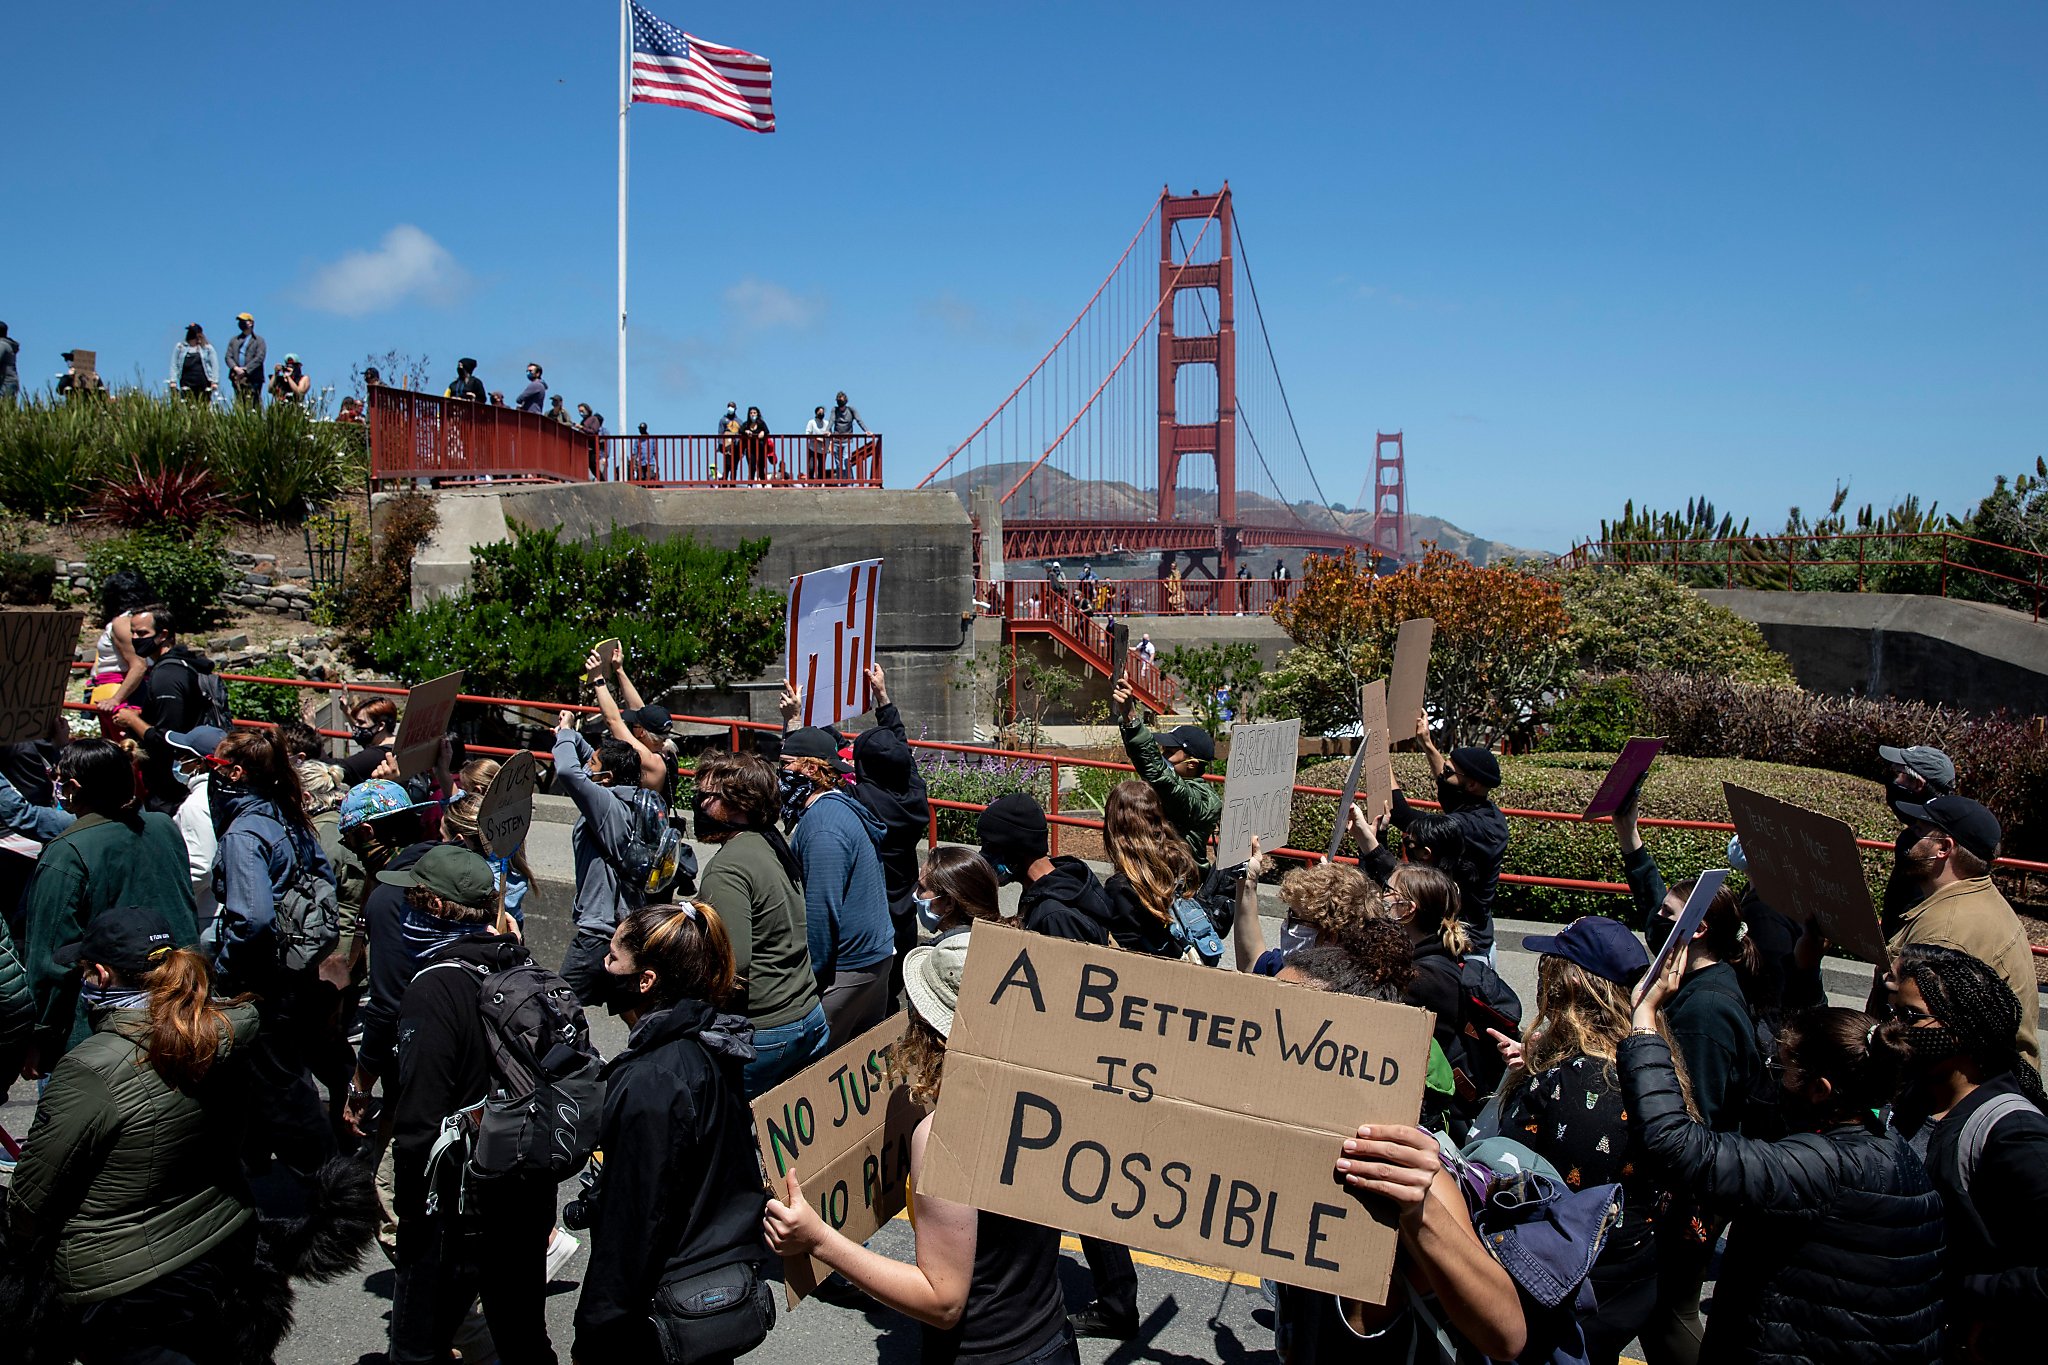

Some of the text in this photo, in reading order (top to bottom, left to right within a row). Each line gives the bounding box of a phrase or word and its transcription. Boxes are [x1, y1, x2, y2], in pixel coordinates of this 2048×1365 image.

[29, 614, 84, 662] MORE
[0, 659, 72, 708] KKILLER
[487, 815, 526, 841] SYSTEM
[1228, 785, 1290, 852] TAYLOR
[989, 948, 1399, 1086] A BETTER WORLD
[766, 1041, 900, 1178] NO JUST
[1092, 1056, 1158, 1102] IS
[863, 1133, 910, 1209] PEA
[1000, 1091, 1347, 1272] POSSIBLE
